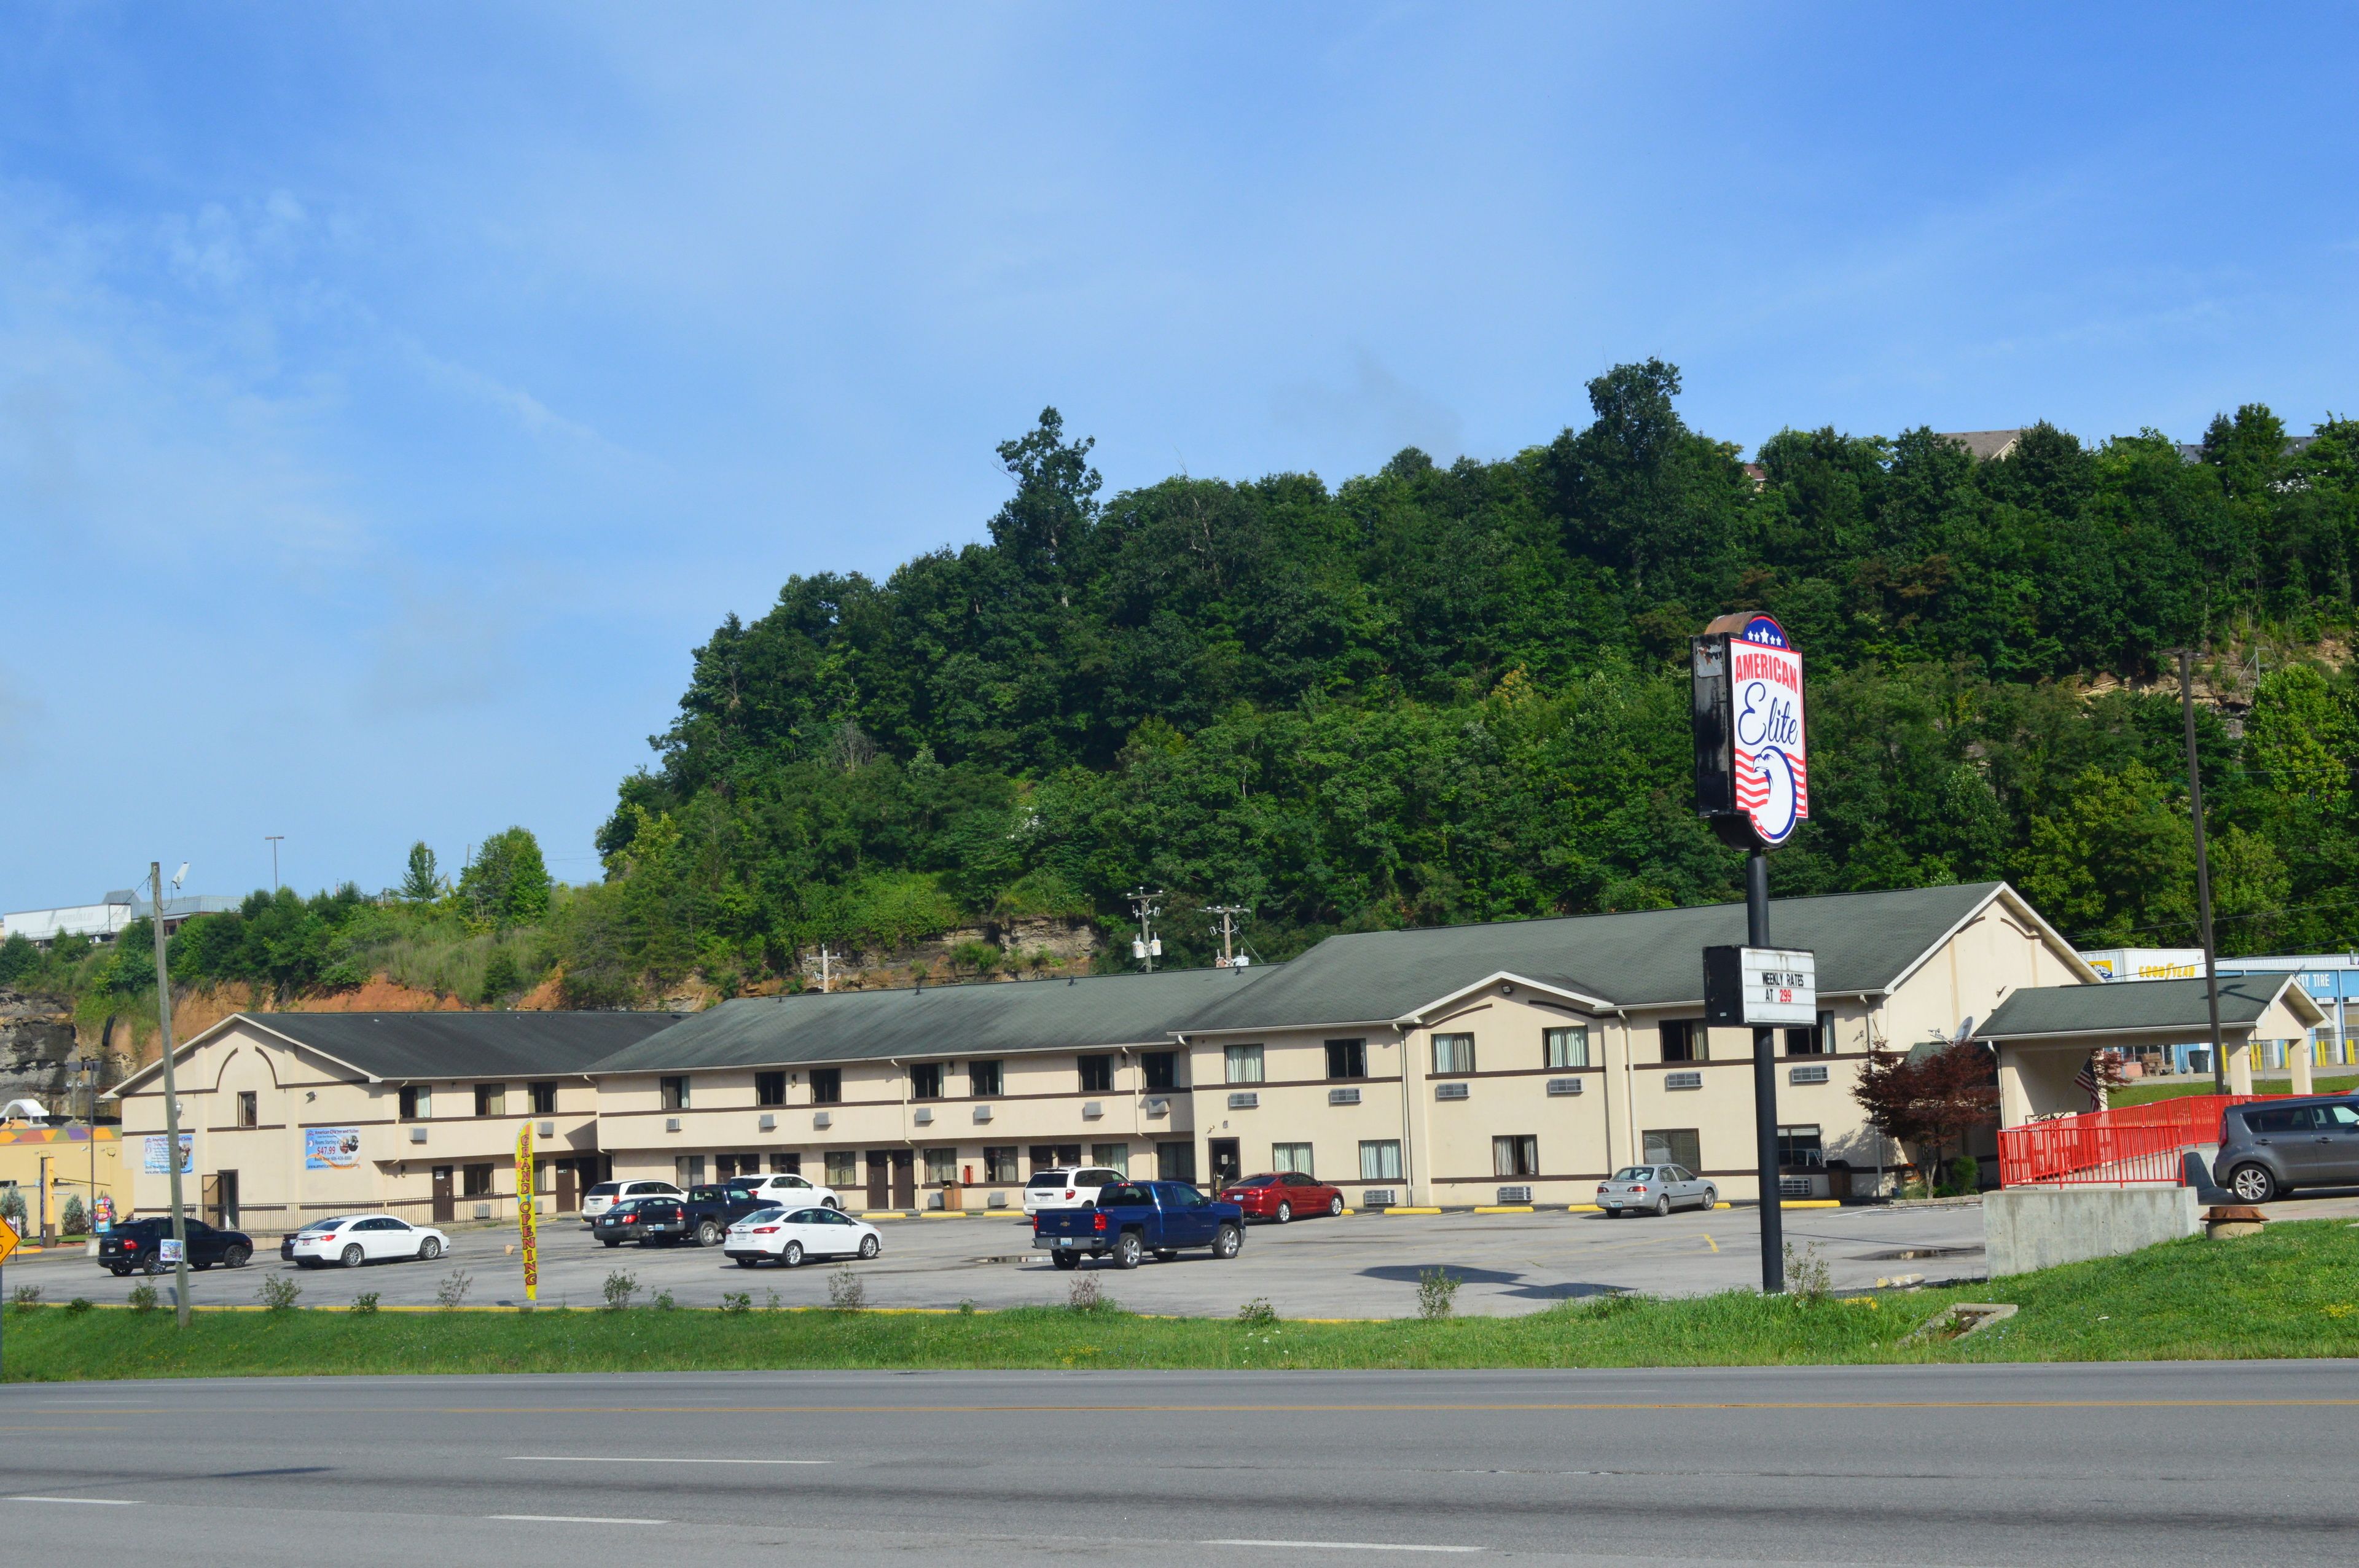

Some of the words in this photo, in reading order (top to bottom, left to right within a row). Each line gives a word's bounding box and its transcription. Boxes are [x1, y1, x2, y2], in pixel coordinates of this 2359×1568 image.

[1735, 653, 1798, 694] AMERICAN
[1738, 682, 1798, 746] Elite
[1762, 972, 1783, 986] WEEKLY
[1786, 973, 1804, 987] RATES
[2138, 962, 2195, 980] GOODYEAR
[2313, 974, 2330, 988] TIRE
[1766, 989, 1774, 1002] AT
[1780, 989, 1792, 1002] 299
[317, 1146, 335, 1155] $47.99
[520, 1134, 531, 1195] GRAND
[520, 1201, 538, 1285] OPENING
